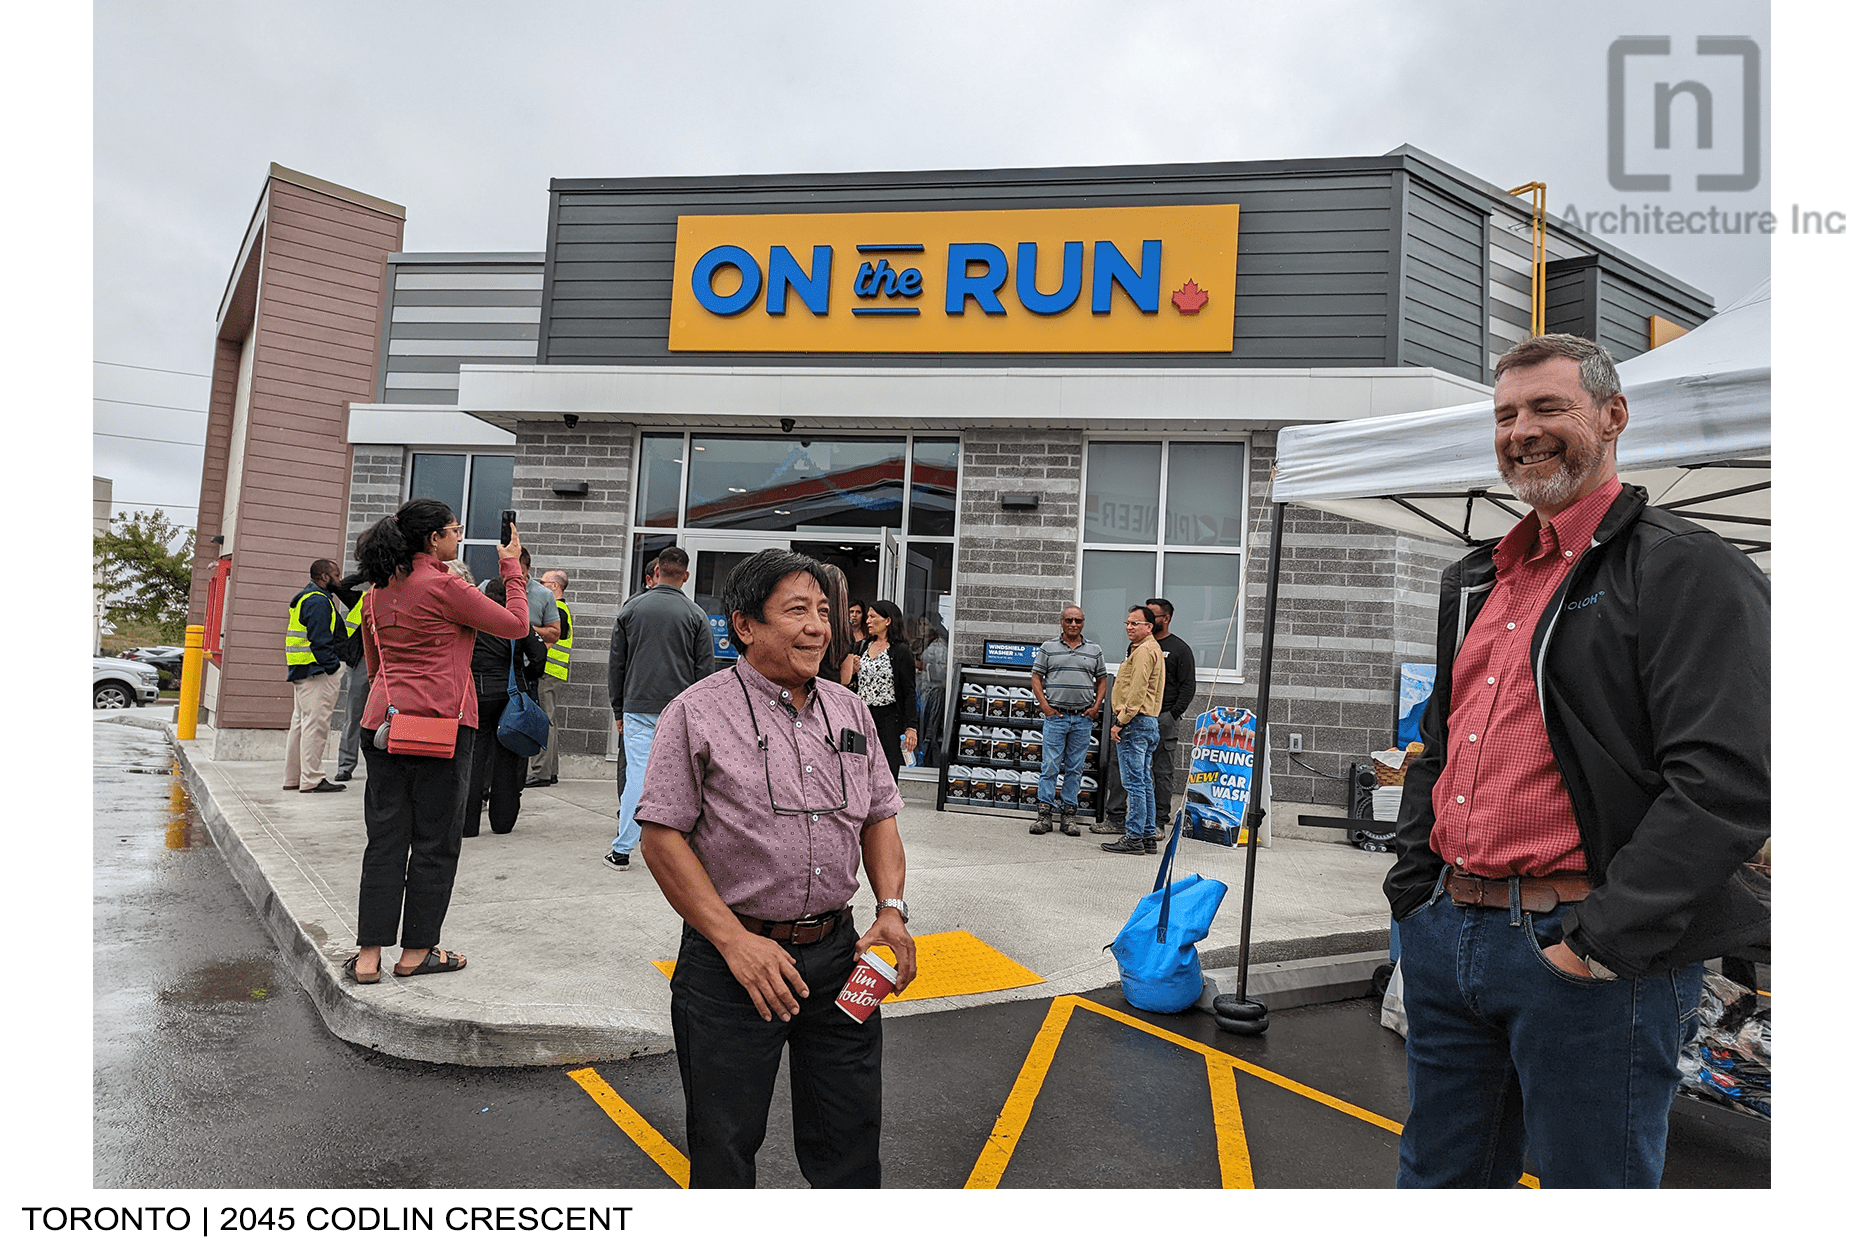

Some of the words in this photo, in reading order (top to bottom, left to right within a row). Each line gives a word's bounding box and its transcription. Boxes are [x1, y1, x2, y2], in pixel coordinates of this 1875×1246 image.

[691, 244, 834, 316] ON
[853, 258, 925, 299] the
[945, 239, 1163, 317] RUN
[1193, 723, 1255, 752] GRAND
[1191, 748, 1254, 767] OPENING
[1189, 771, 1219, 784] NEW!
[1219, 773, 1247, 789] CAR
[1211, 785, 1250, 804] WASH
[851, 965, 876, 988] Tim
